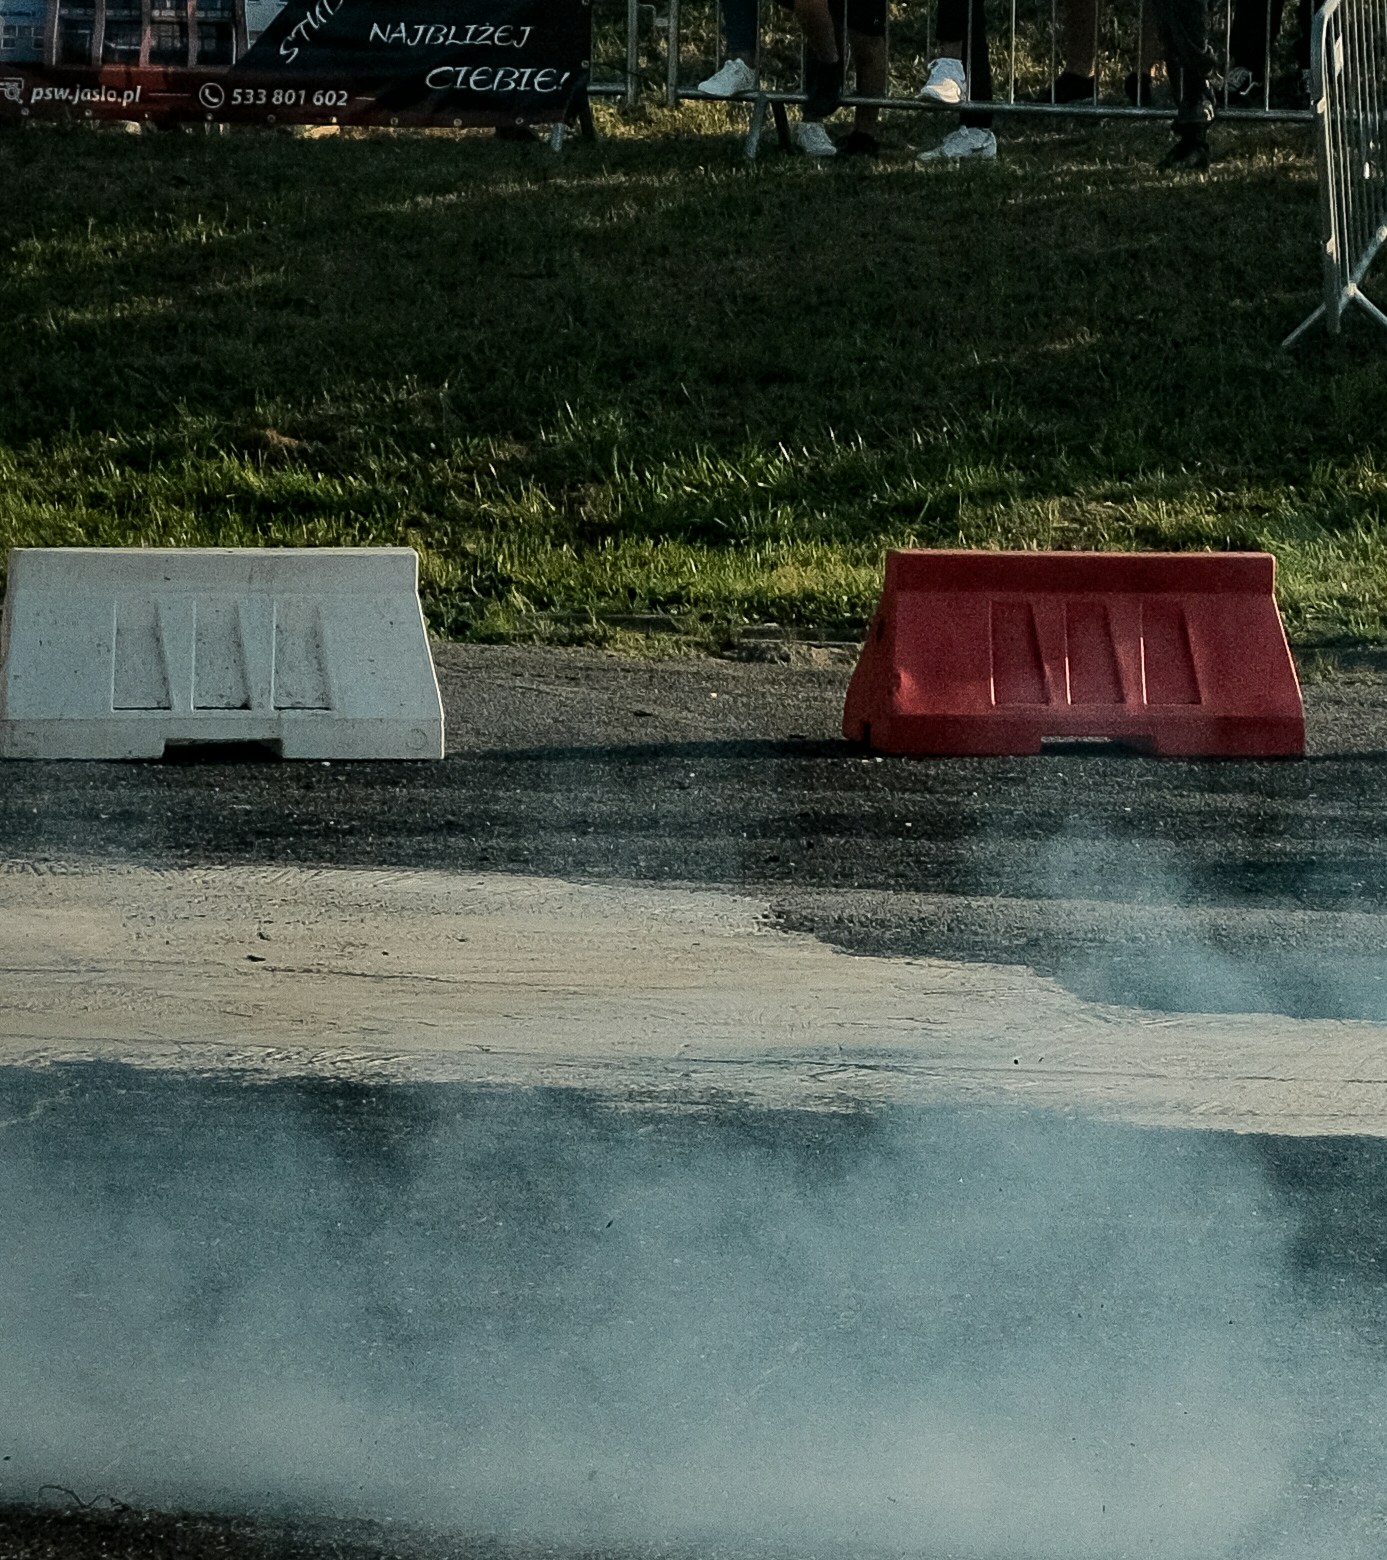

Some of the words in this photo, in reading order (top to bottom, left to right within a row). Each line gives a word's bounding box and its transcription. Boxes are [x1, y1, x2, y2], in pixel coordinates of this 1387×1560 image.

[369, 22, 532, 48] NAJBLIŻEJ
[425, 65, 571, 93] CIEBIE!
[31, 84, 142, 107] psw.jaslo.pl
[231, 88, 268, 106] 533
[271, 88, 306, 107] 801
[311, 89, 349, 107] 602
